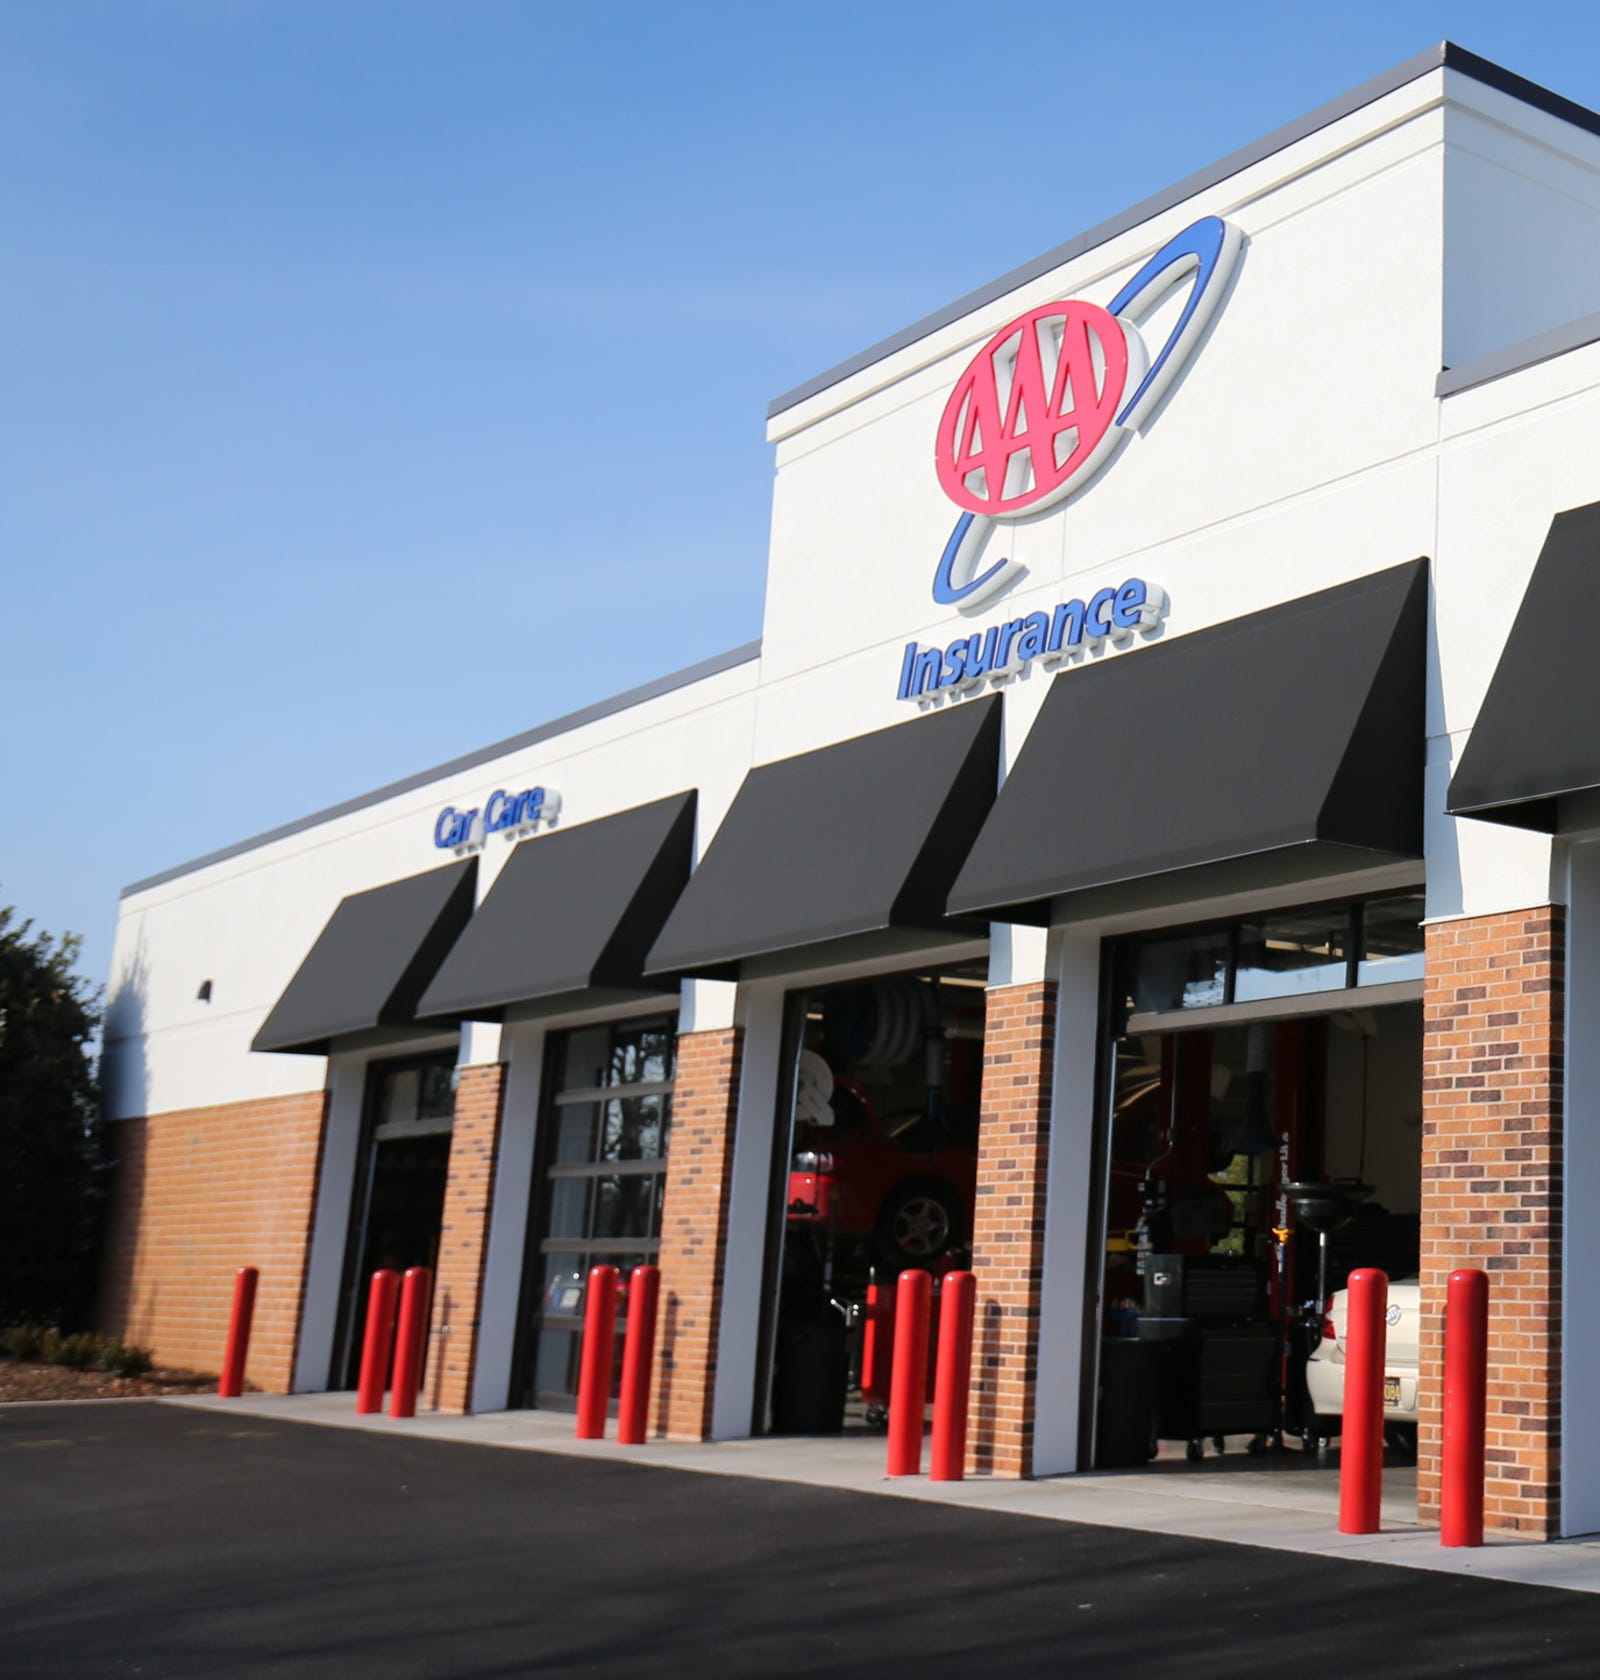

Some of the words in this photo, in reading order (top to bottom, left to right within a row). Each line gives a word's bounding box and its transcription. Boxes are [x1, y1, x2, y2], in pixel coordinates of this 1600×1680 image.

[942, 306, 1120, 508] AAA
[897, 577, 1147, 700] Insurance
[434, 807, 479, 848] Car
[484, 786, 545, 833] Care
[1275, 1162, 1290, 1231] halleger
